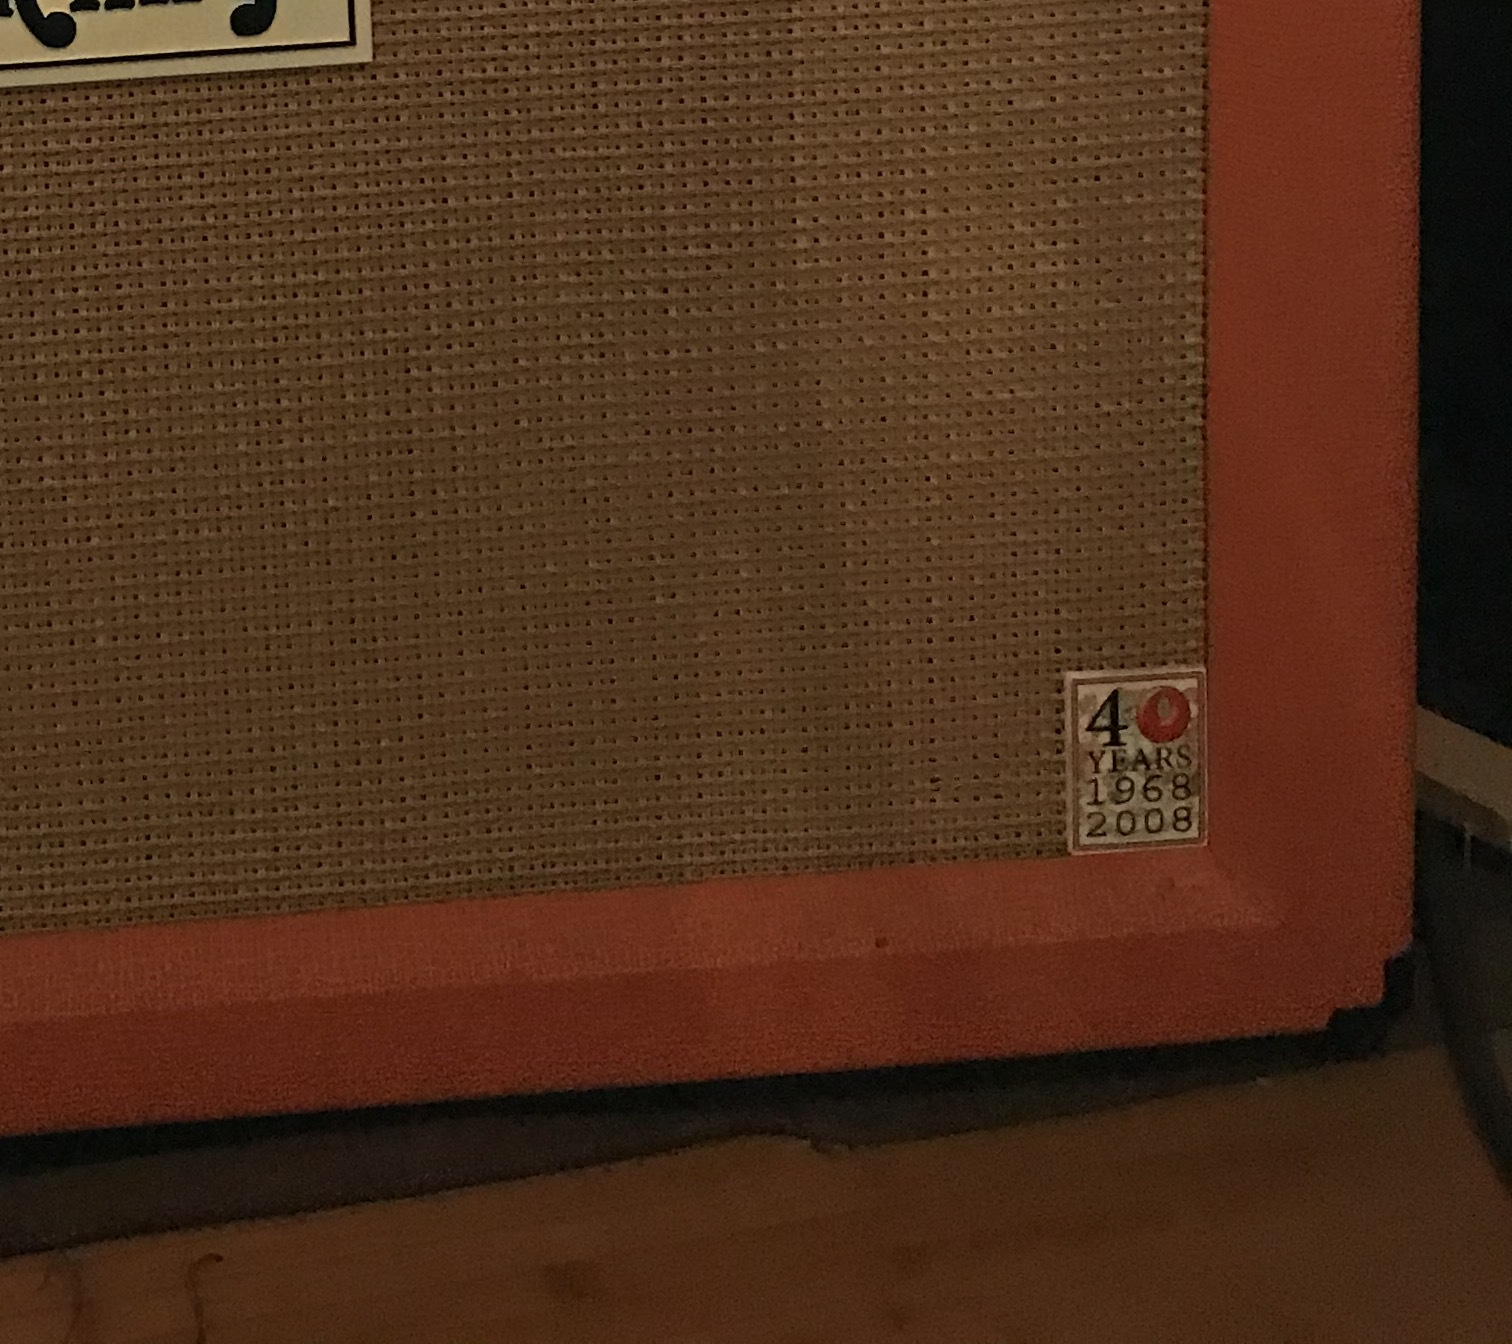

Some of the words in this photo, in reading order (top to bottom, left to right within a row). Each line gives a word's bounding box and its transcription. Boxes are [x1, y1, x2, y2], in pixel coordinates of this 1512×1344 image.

[1085, 685, 1192, 747] 40
[1088, 744, 1193, 774] YEARS
[1086, 772, 1192, 806] 1968
[1086, 805, 1193, 838] 2008
